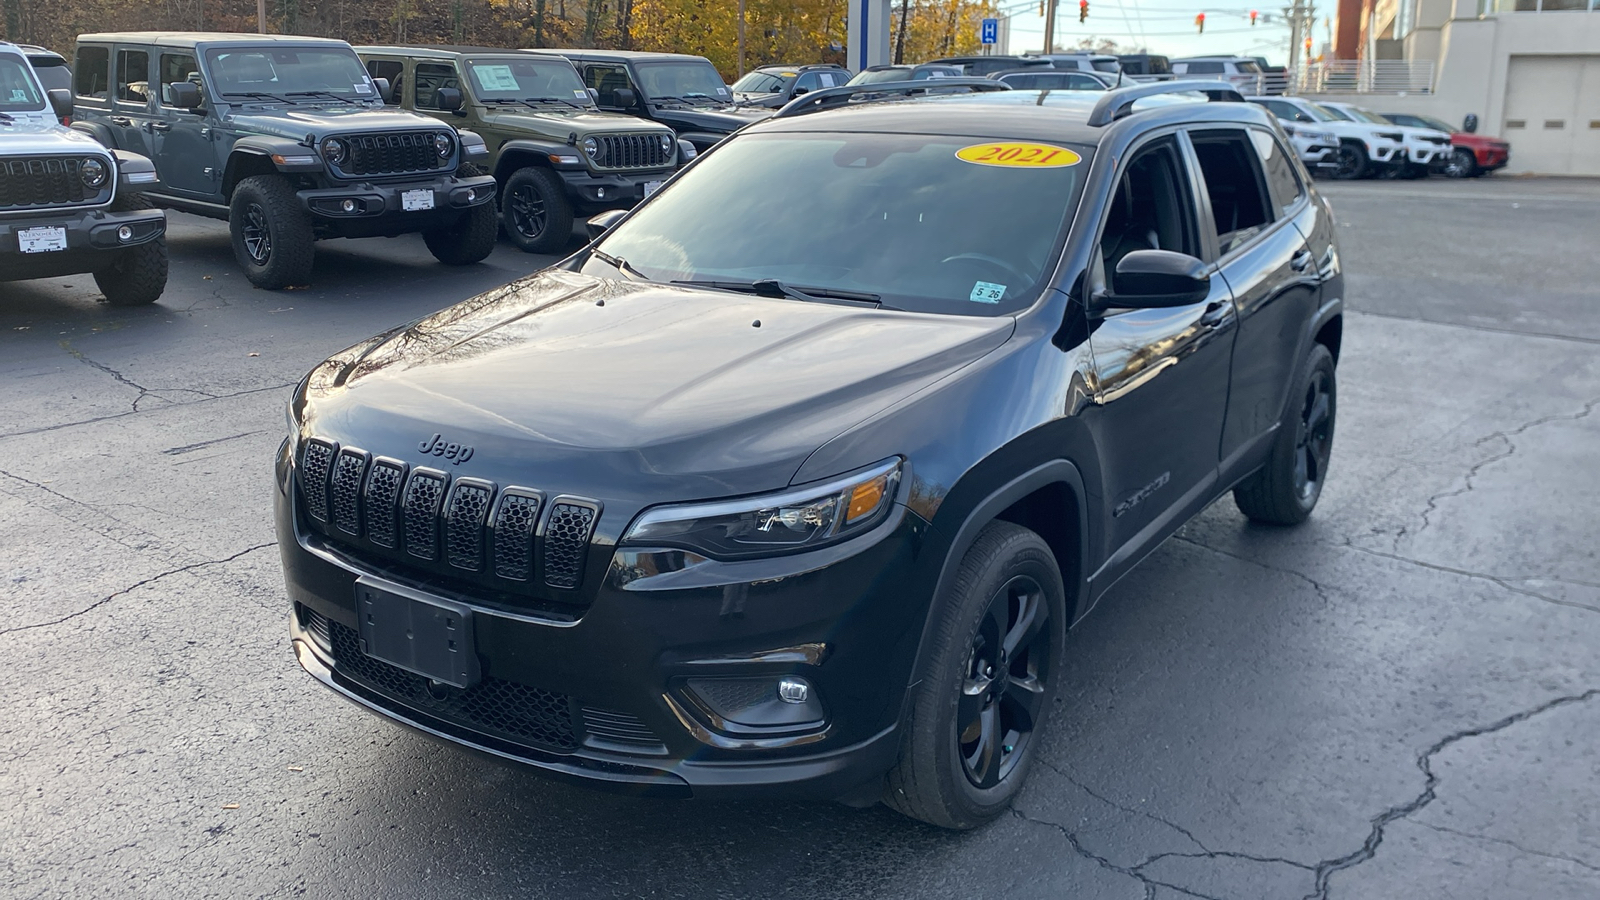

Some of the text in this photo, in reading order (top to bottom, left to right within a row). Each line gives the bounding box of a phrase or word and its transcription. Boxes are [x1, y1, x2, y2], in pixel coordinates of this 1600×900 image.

[985, 24, 994, 37] H
[975, 147, 1062, 163] 2021
[976, 287, 1000, 299] 5 26
[418, 432, 474, 466] Jeep
